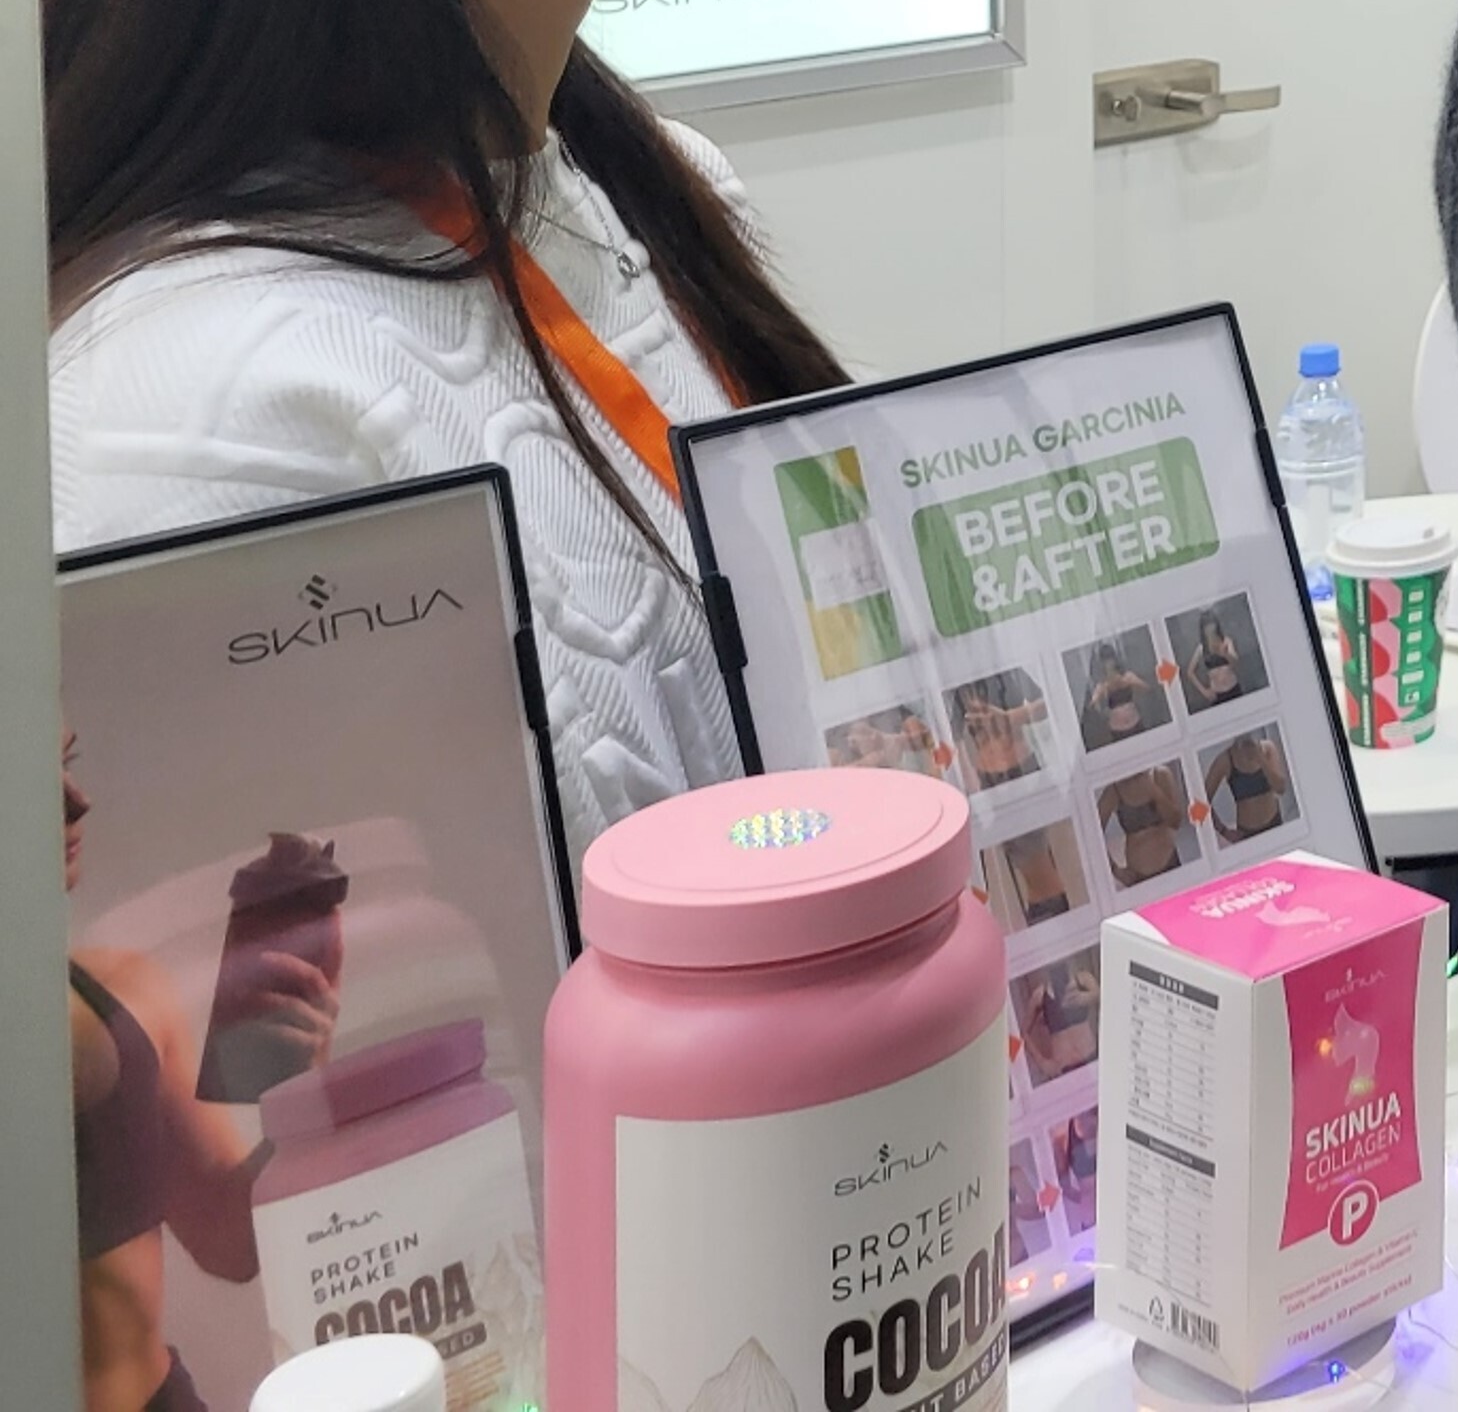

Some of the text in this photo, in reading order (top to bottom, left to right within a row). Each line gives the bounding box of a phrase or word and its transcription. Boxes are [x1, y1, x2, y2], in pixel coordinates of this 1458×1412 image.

[900, 391, 1186, 489] SKINUA GARCINIA
[954, 461, 1166, 557] BEFORE
[972, 514, 1176, 613] &AFTER
[1306, 1092, 1401, 1160] SKINUA
[1306, 1123, 1401, 1184] COLLAGEN
[833, 1176, 981, 1270] PROTEIN
[1342, 1192, 1370, 1240] P
[311, 1232, 420, 1286] PROTEIN
[313, 1260, 398, 1305] SHAKE
[833, 1228, 953, 1301] SHAKE
[314, 1261, 476, 1348] COCOA
